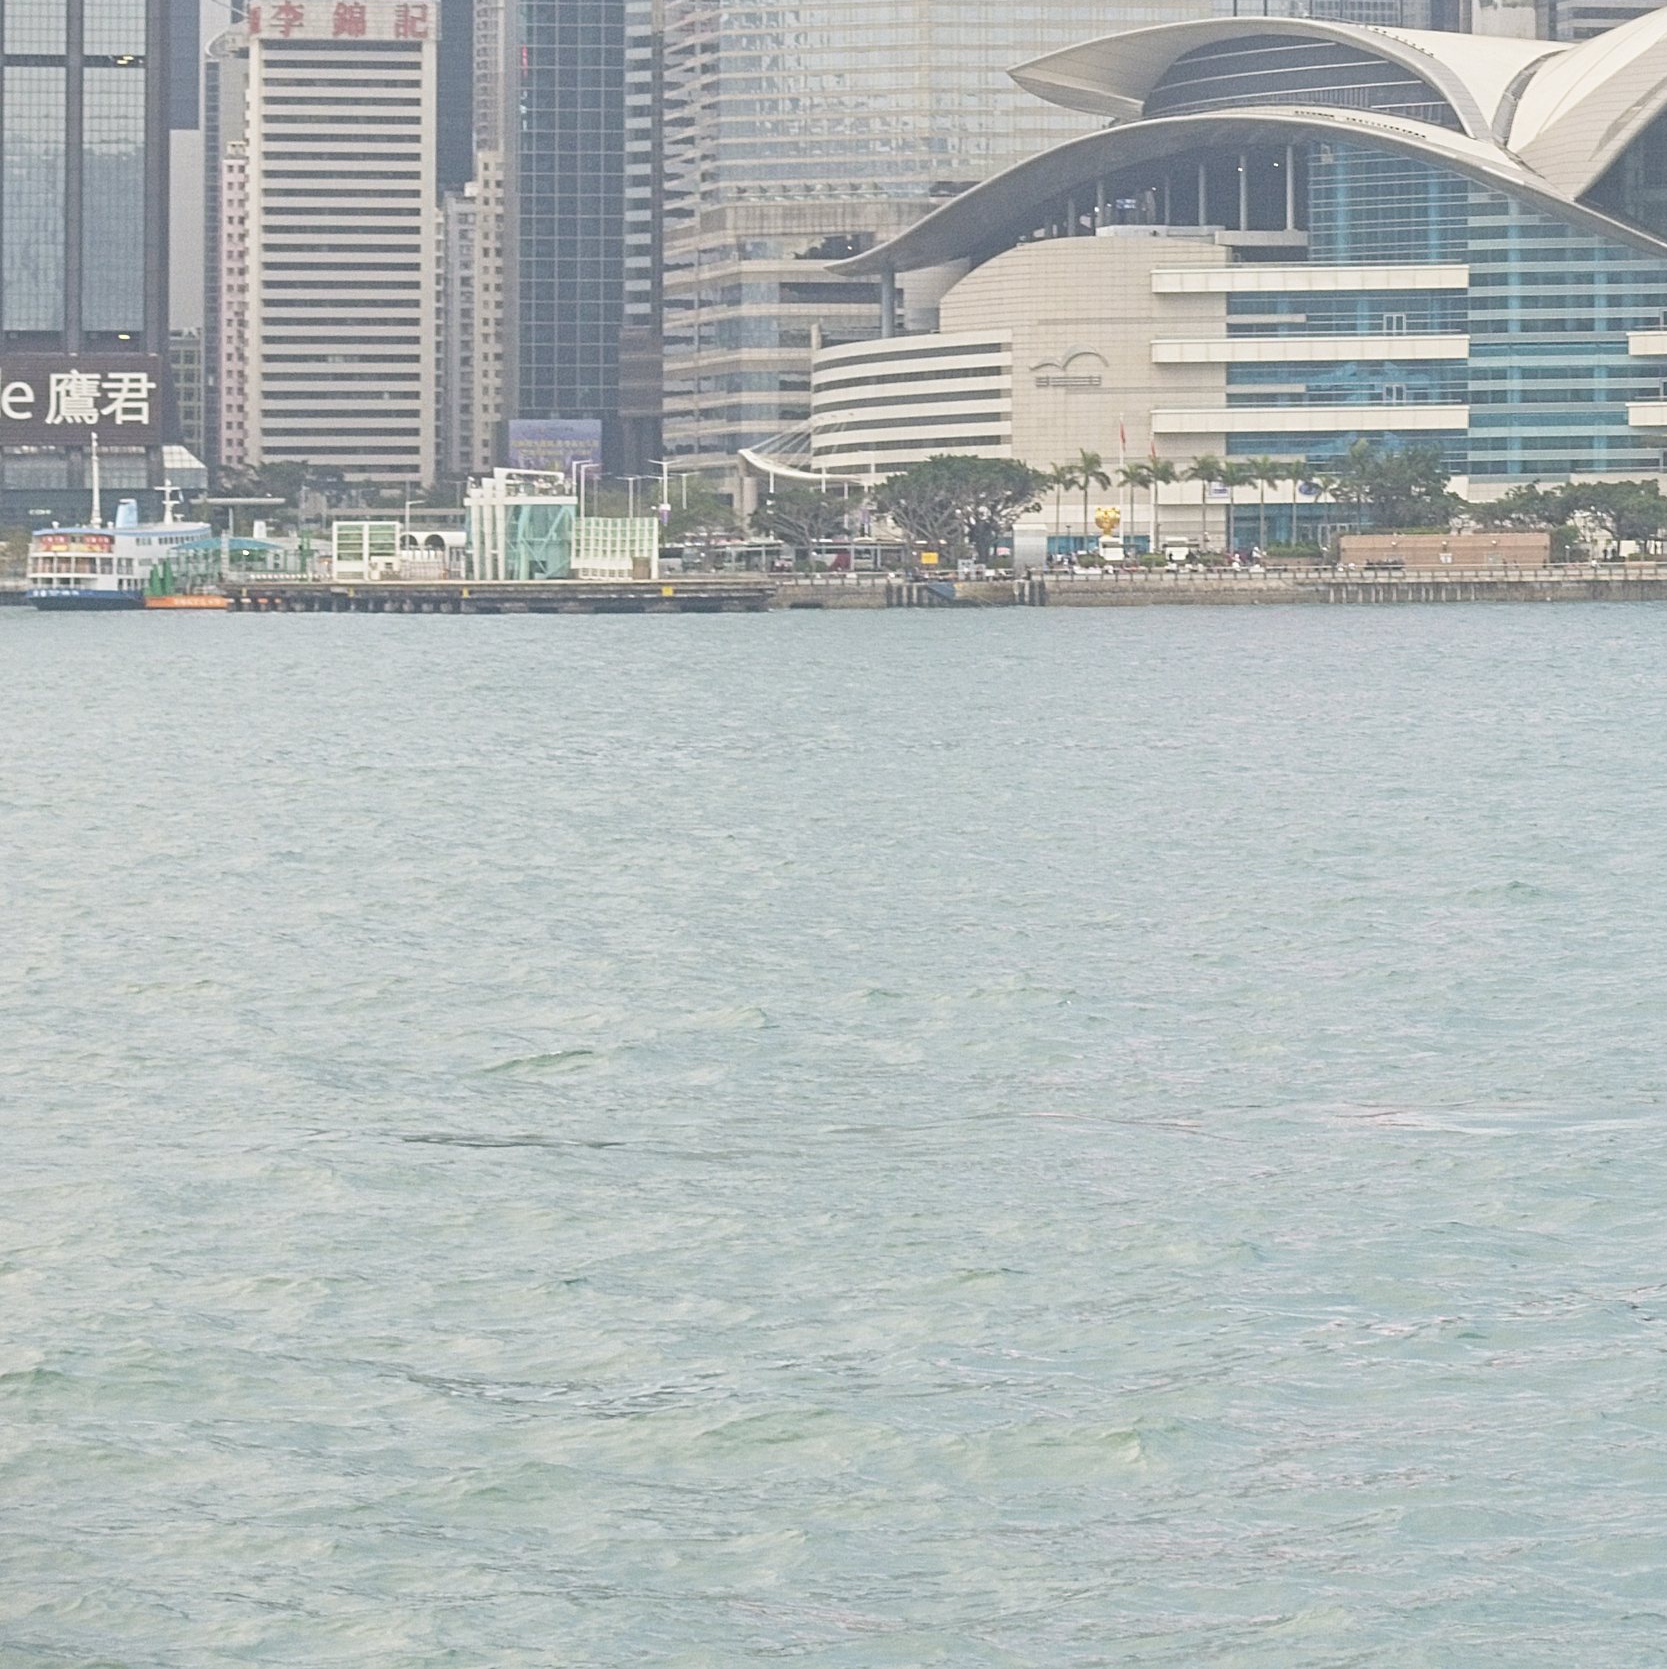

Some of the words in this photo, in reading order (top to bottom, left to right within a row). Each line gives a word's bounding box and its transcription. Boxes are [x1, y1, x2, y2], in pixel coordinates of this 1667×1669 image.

[269, 0, 429, 39] 李錦記
[0, 378, 35, 420] e
[45, 368, 157, 425] 鷹君
